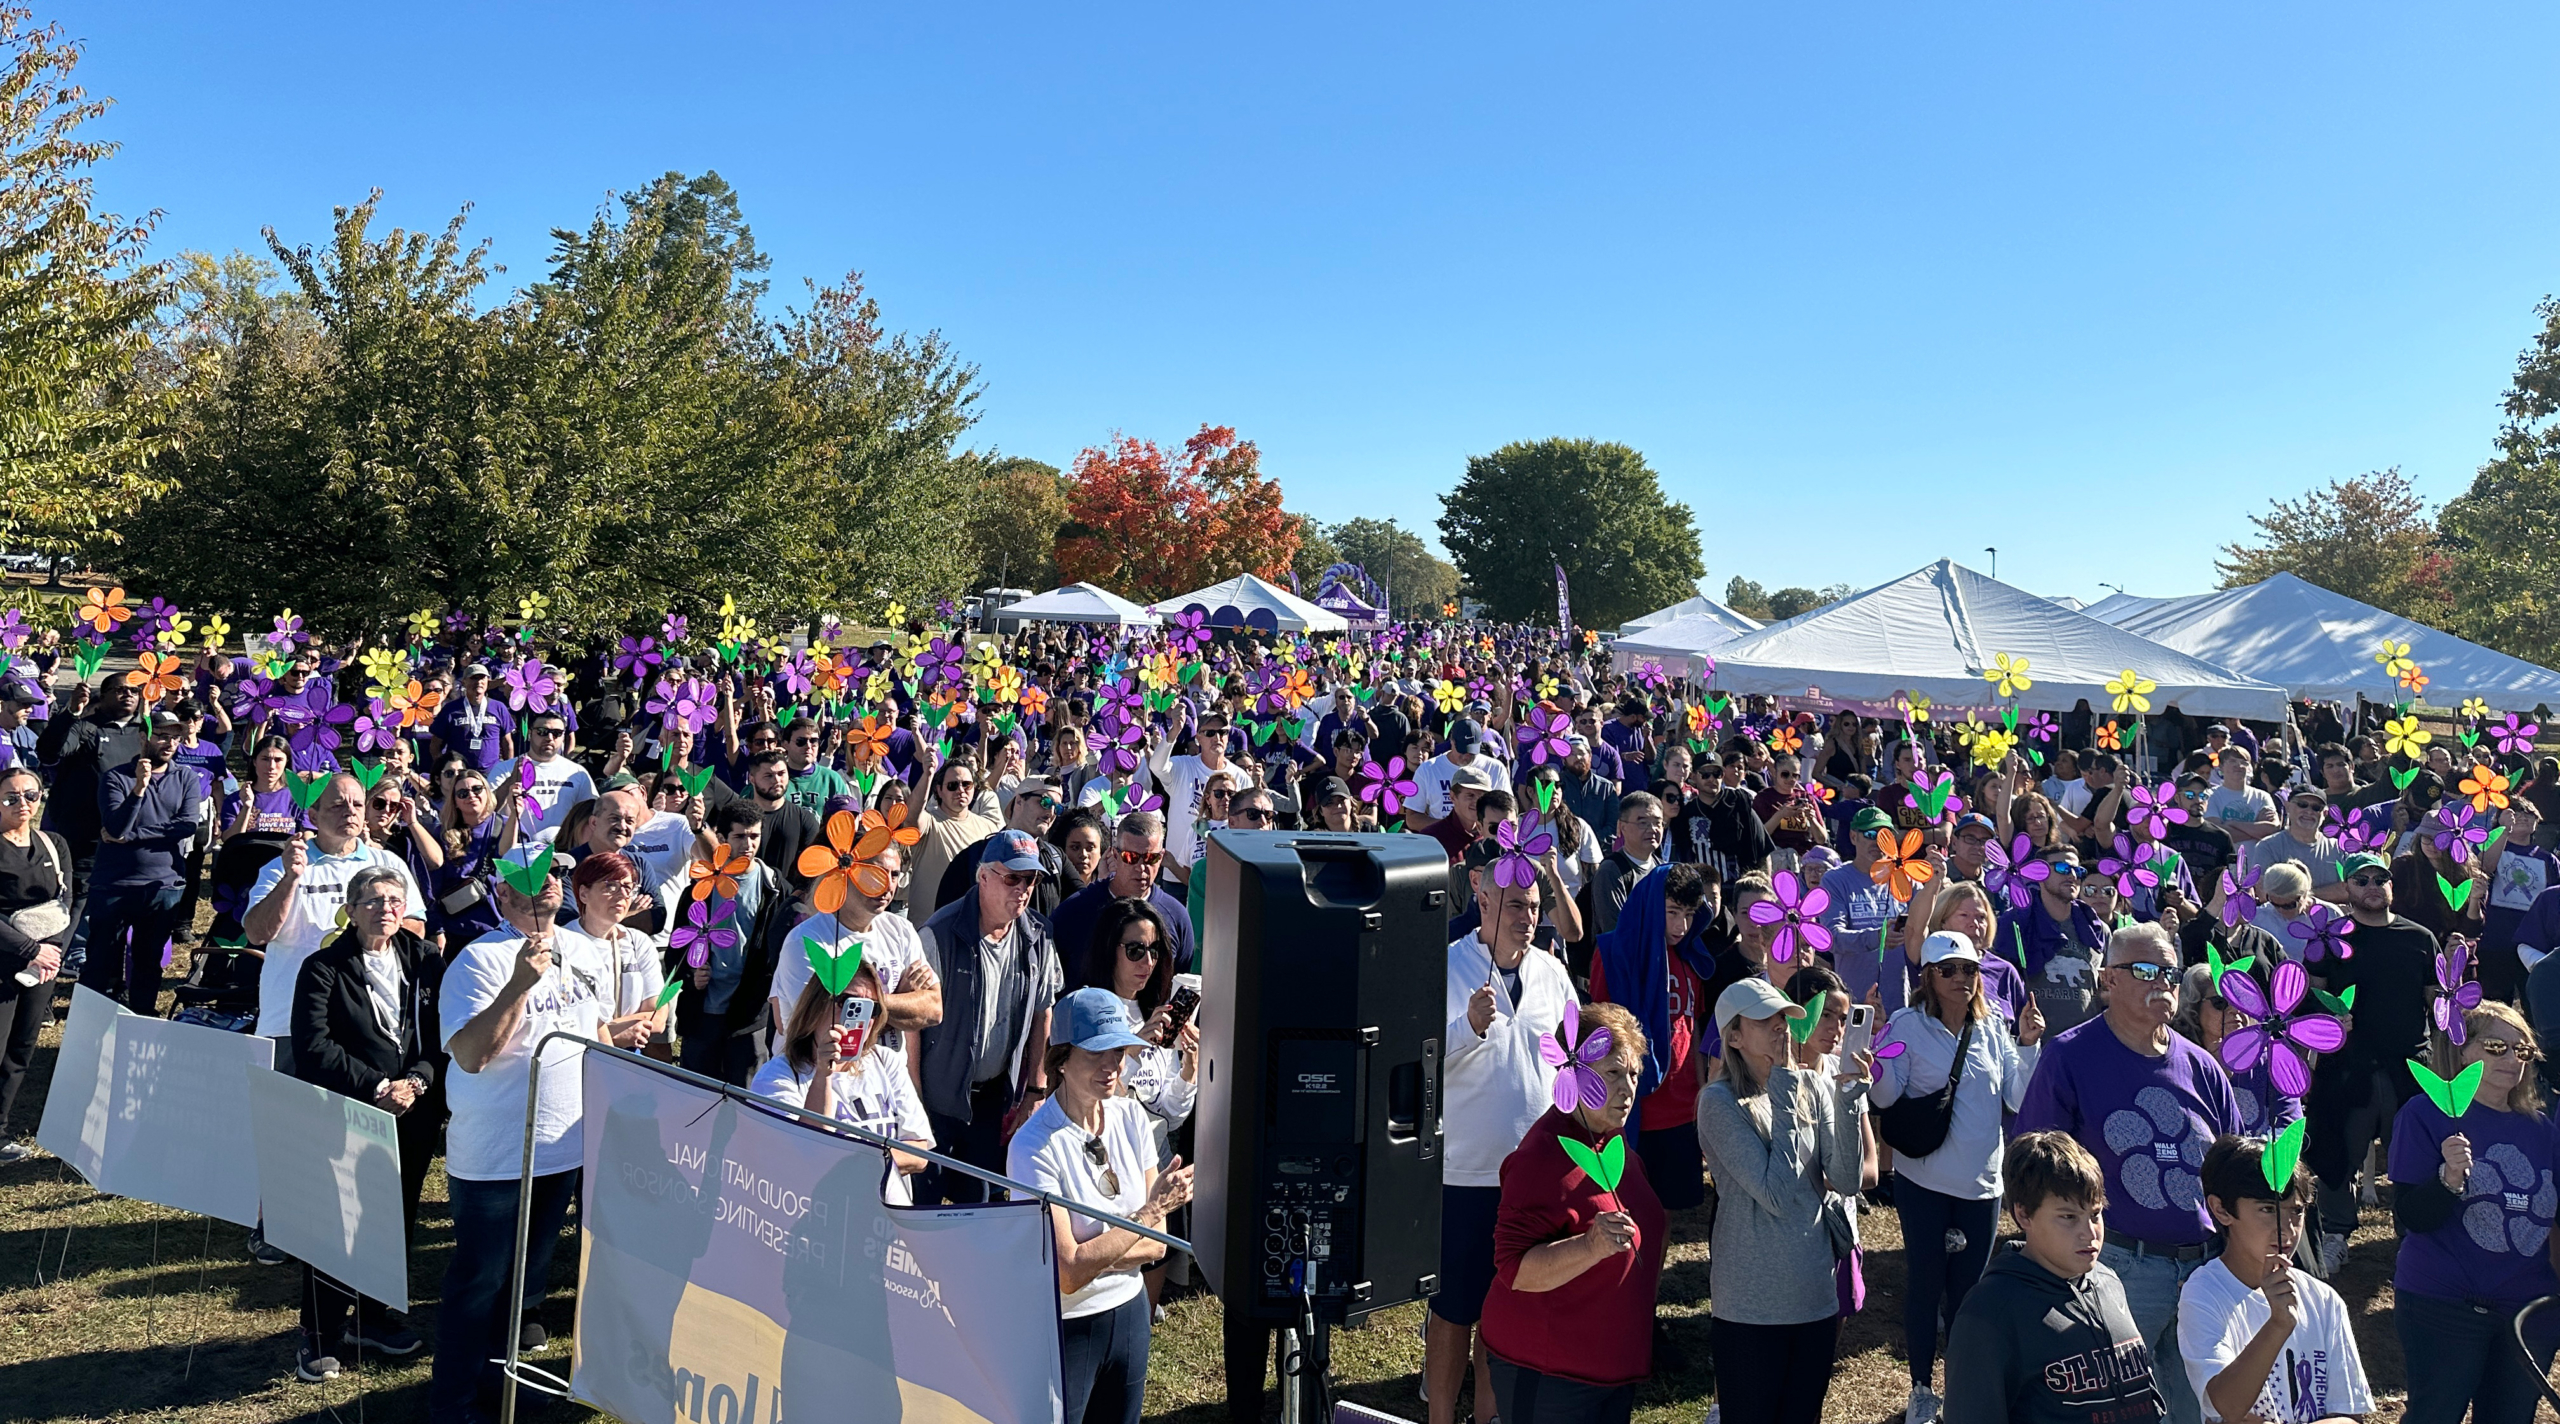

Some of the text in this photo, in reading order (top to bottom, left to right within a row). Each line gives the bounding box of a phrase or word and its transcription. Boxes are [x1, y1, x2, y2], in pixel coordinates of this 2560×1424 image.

[1325, 781, 1337, 790] alo
[1852, 904, 1889, 912] END
[1298, 1074, 1336, 1083] QSC
[2154, 1142, 2176, 1150] WALK
[2161, 1148, 2178, 1156] END
[2503, 1192, 2529, 1201] WALK
[2045, 1339, 2149, 1392] ST. JOHN
[2313, 1349, 2327, 1416] ALZHEIME
[2091, 1411, 2116, 1424] RED
